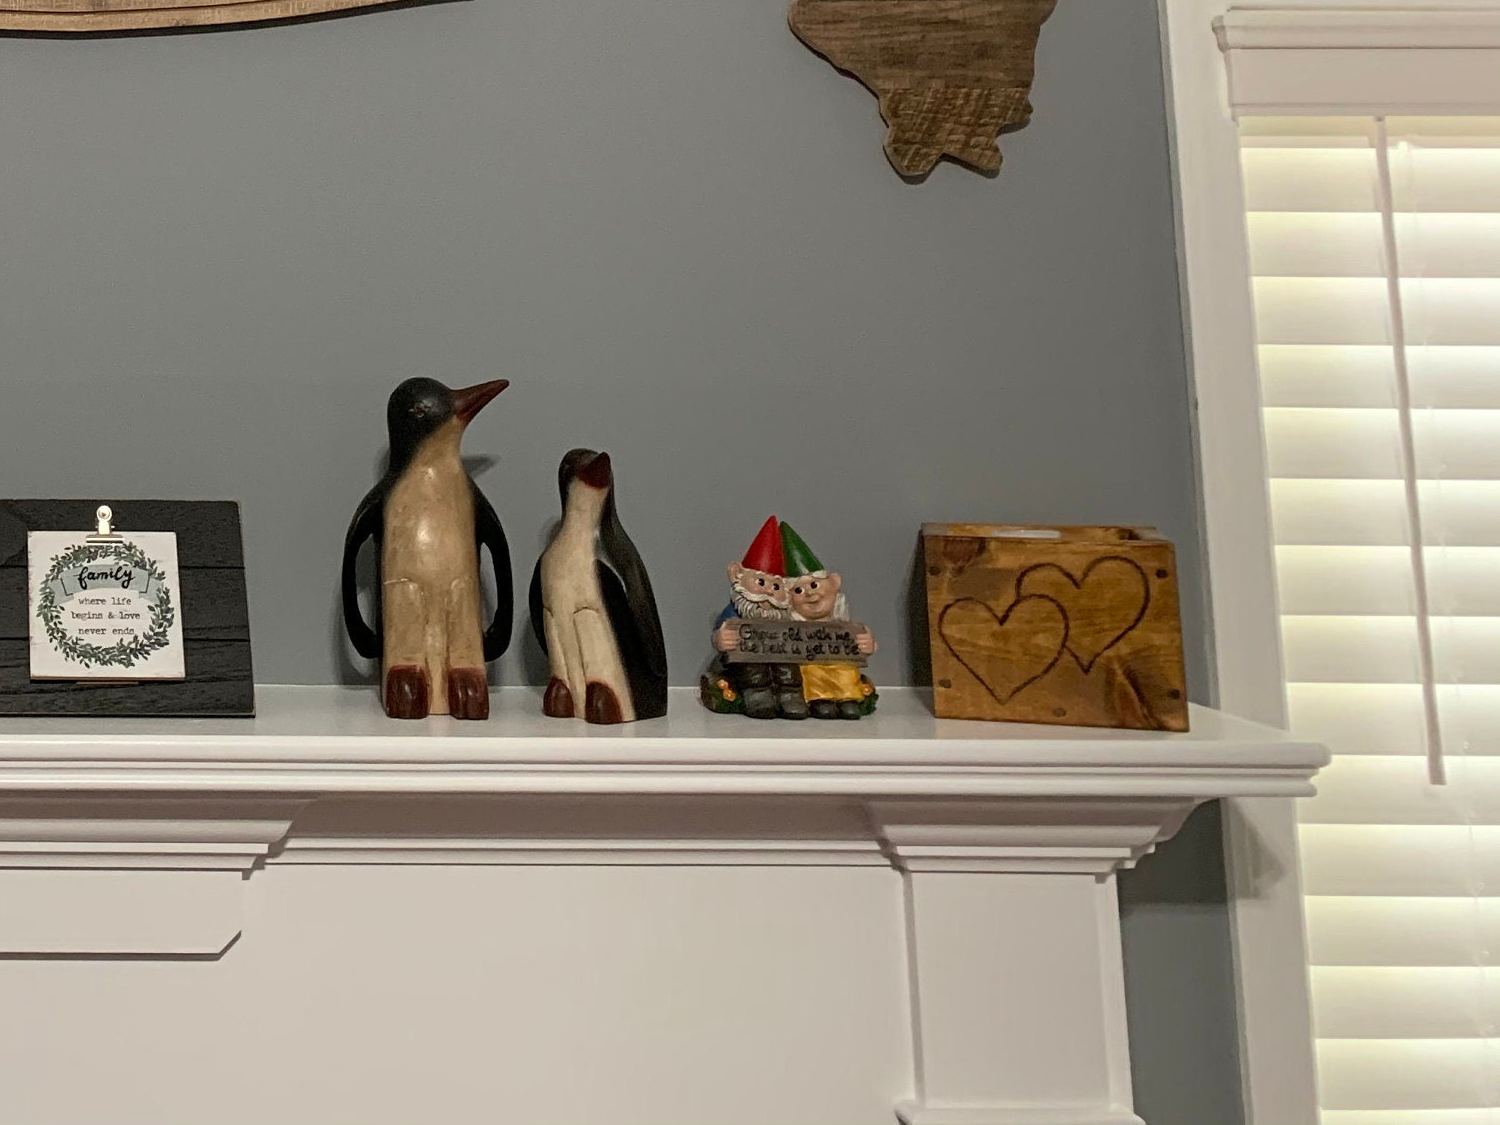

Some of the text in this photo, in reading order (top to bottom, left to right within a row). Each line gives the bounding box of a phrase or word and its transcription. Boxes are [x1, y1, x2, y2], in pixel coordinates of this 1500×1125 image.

[73, 566, 136, 590] family
[78, 597, 132, 606] where life
[71, 611, 141, 621] begins & love
[112, 627, 135, 635] ends
[805, 627, 832, 641] with
[740, 640, 758, 653] the
[806, 643, 825, 661] yet
[828, 644, 839, 654] to
